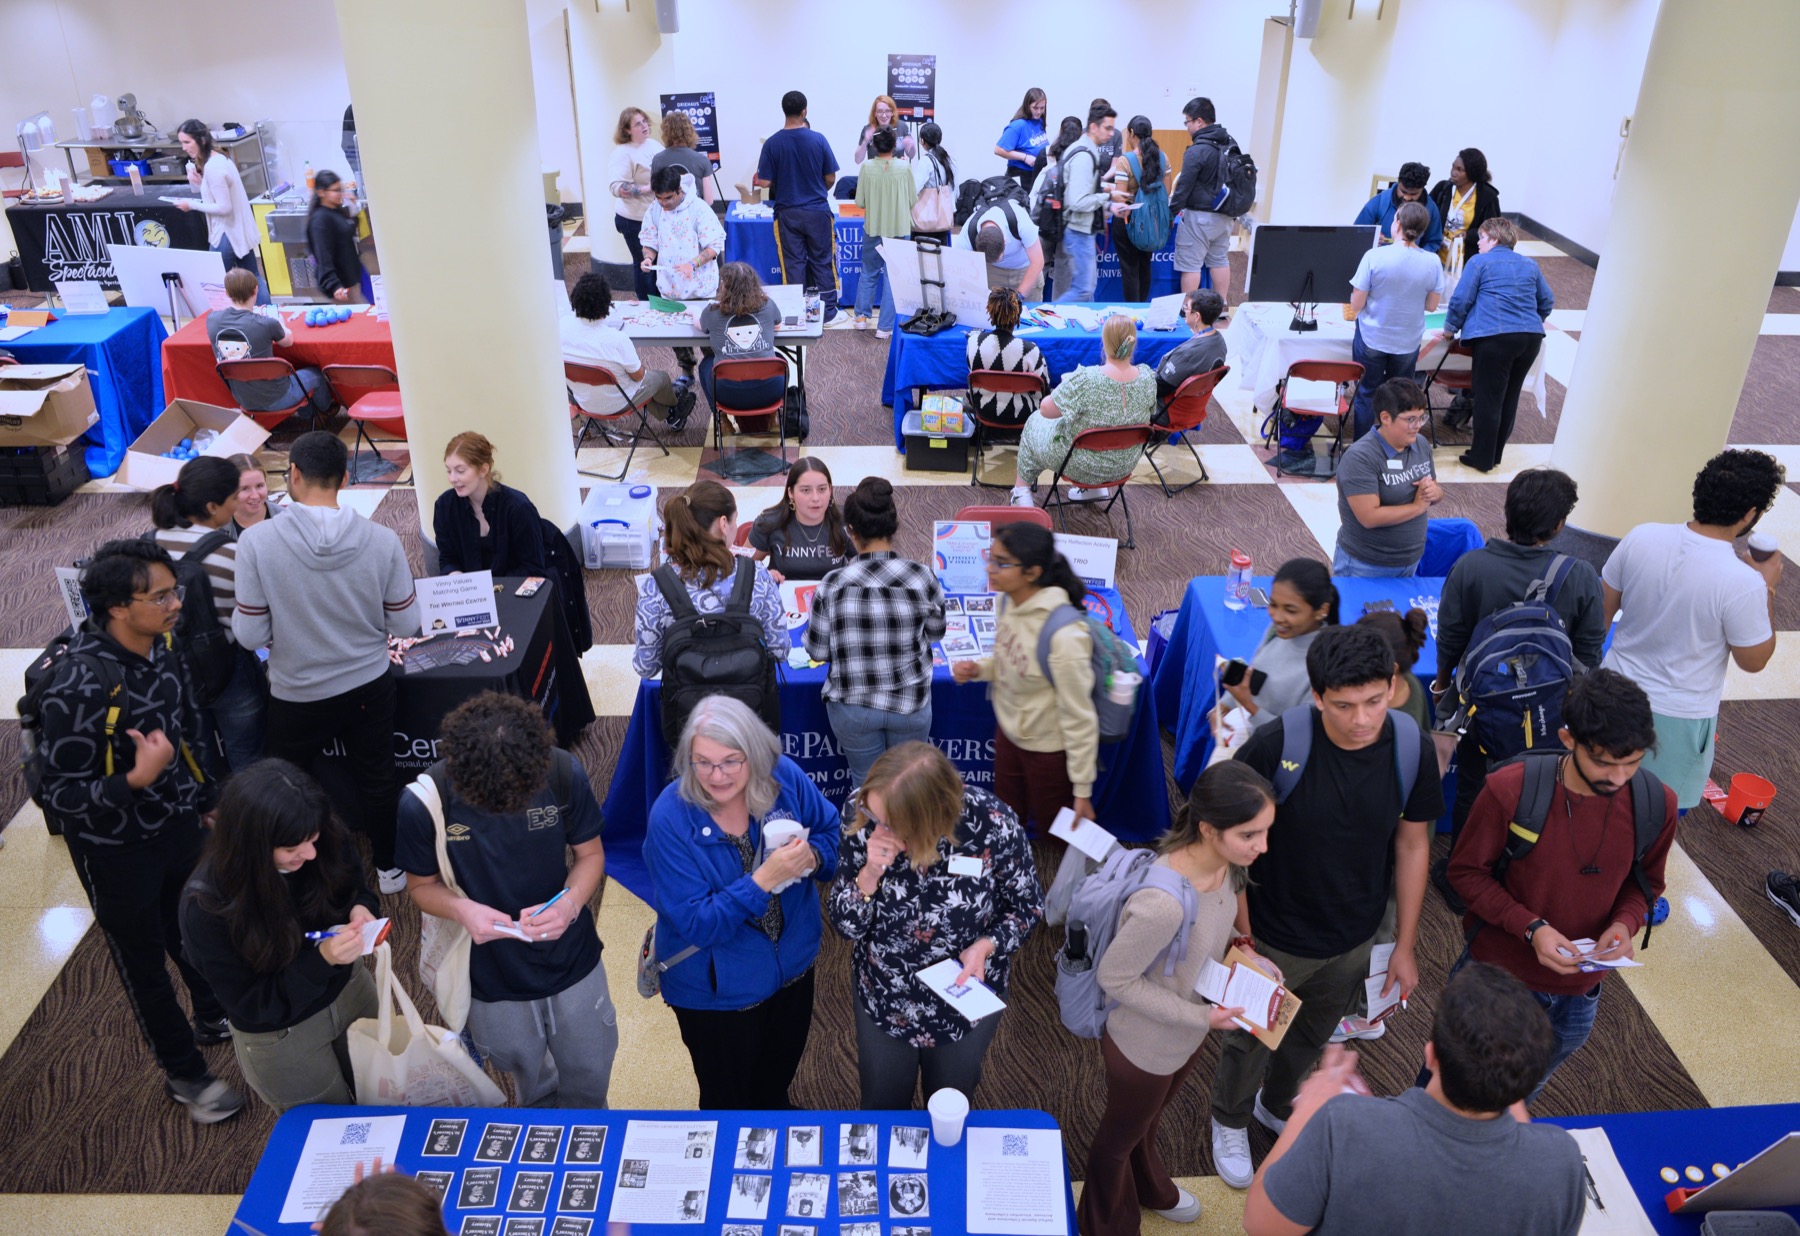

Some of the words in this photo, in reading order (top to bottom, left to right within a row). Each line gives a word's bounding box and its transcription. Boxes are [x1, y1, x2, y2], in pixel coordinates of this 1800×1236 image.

[1382, 460, 1431, 486] VINNYFES
[432, 588, 459, 596] Matching
[471, 1221, 492, 1229] Memory
[561, 1222, 582, 1230] Memory
